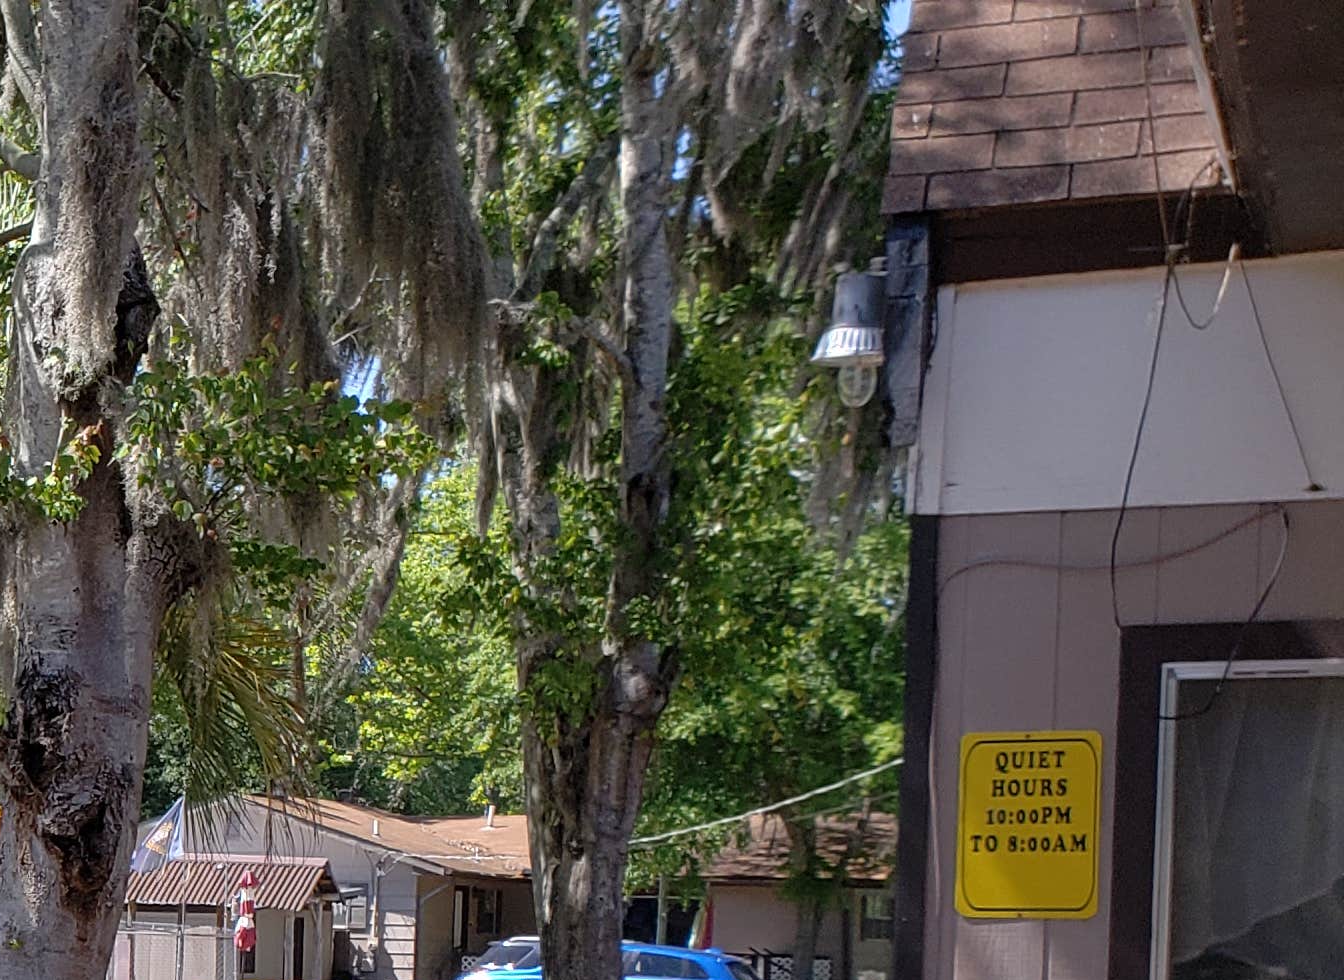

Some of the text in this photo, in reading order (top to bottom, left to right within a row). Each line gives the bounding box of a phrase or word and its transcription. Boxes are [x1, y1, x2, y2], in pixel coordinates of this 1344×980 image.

[995, 751, 1066, 773] QUIET
[992, 779, 1068, 797] HOURS
[986, 806, 1072, 825] 10:00PM
[970, 834, 1087, 852] TO 8:00AM
